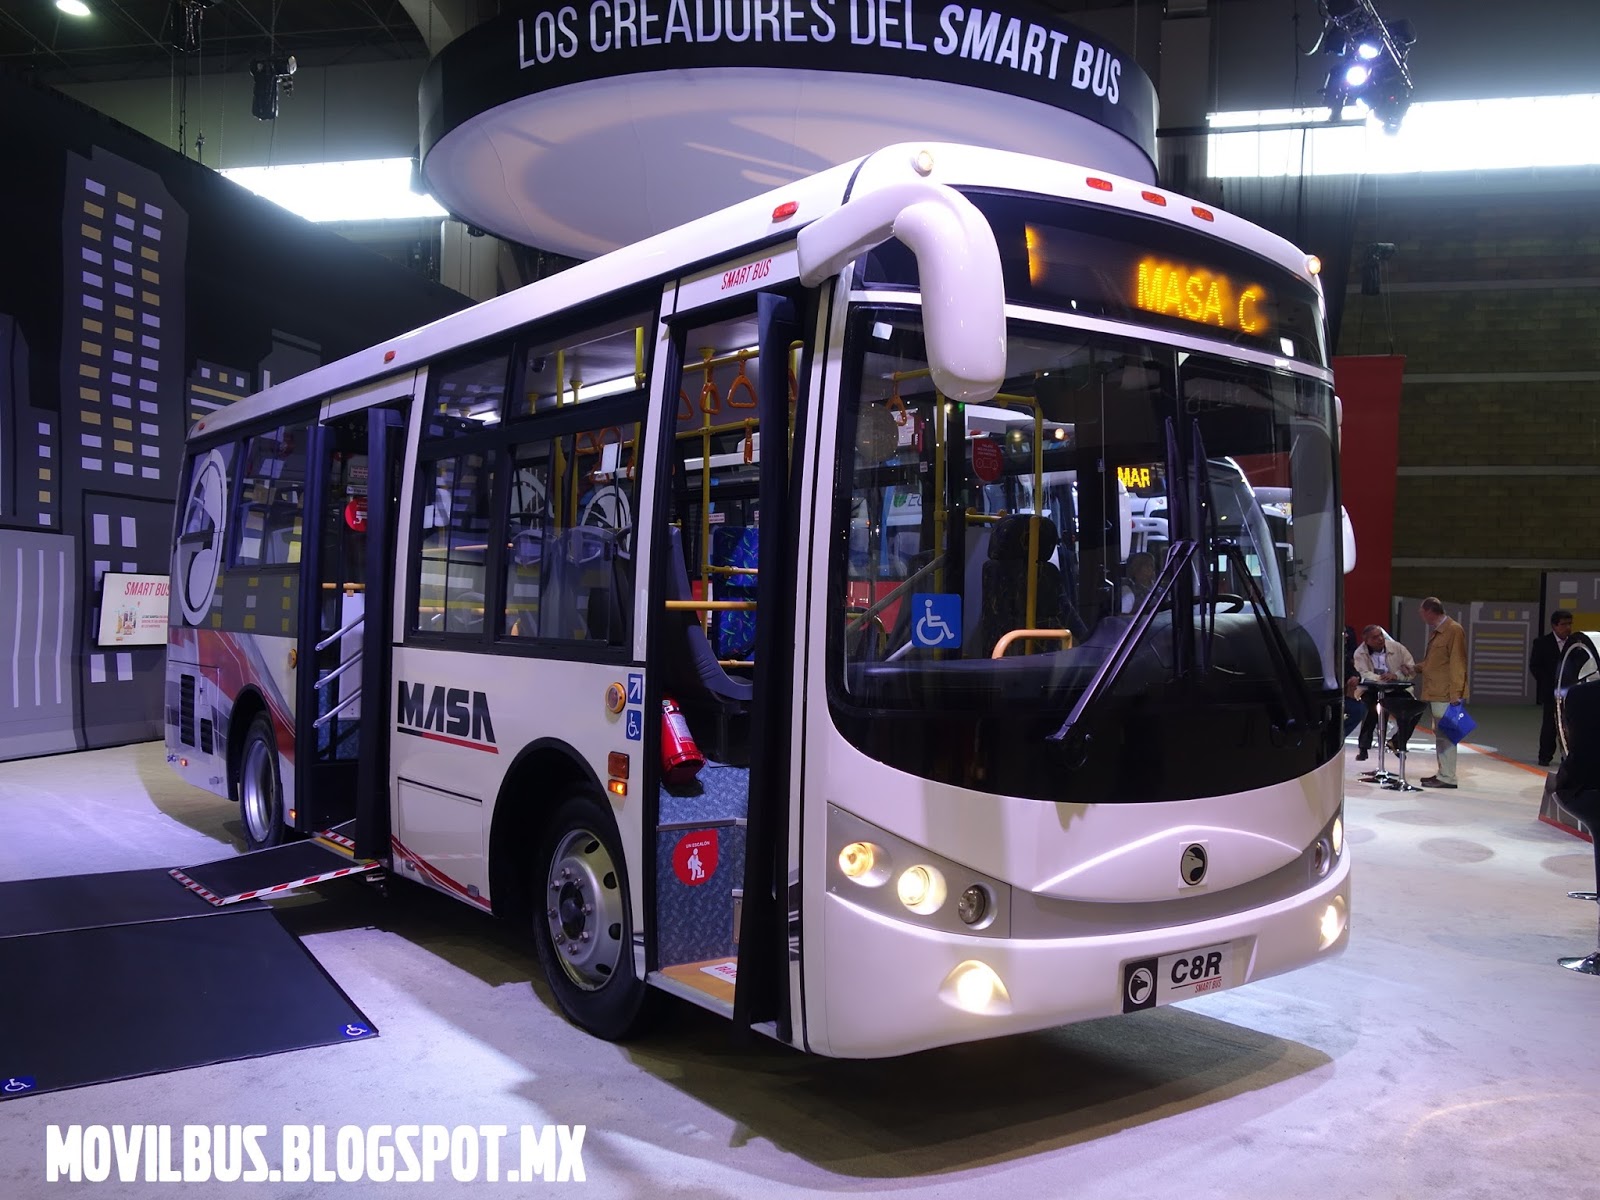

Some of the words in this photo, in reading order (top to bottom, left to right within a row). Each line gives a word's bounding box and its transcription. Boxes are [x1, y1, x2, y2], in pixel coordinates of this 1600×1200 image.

[519, 6, 578, 69] LOS
[850, 0, 927, 51] DEL
[934, 4, 1068, 80] SMART
[1072, 40, 1121, 104] BUS
[722, 265, 752, 290] SMART
[752, 259, 772, 281] BUS
[1137, 262, 1224, 326] MASA
[1238, 290, 1256, 332] C
[125, 582, 155, 596] SMART
[155, 583, 170, 597] BUS
[397, 680, 496, 743] MASA
[1171, 951, 1222, 984] C8R
[1194, 981, 1211, 993] SMART
[1211, 979, 1222, 991] BUS
